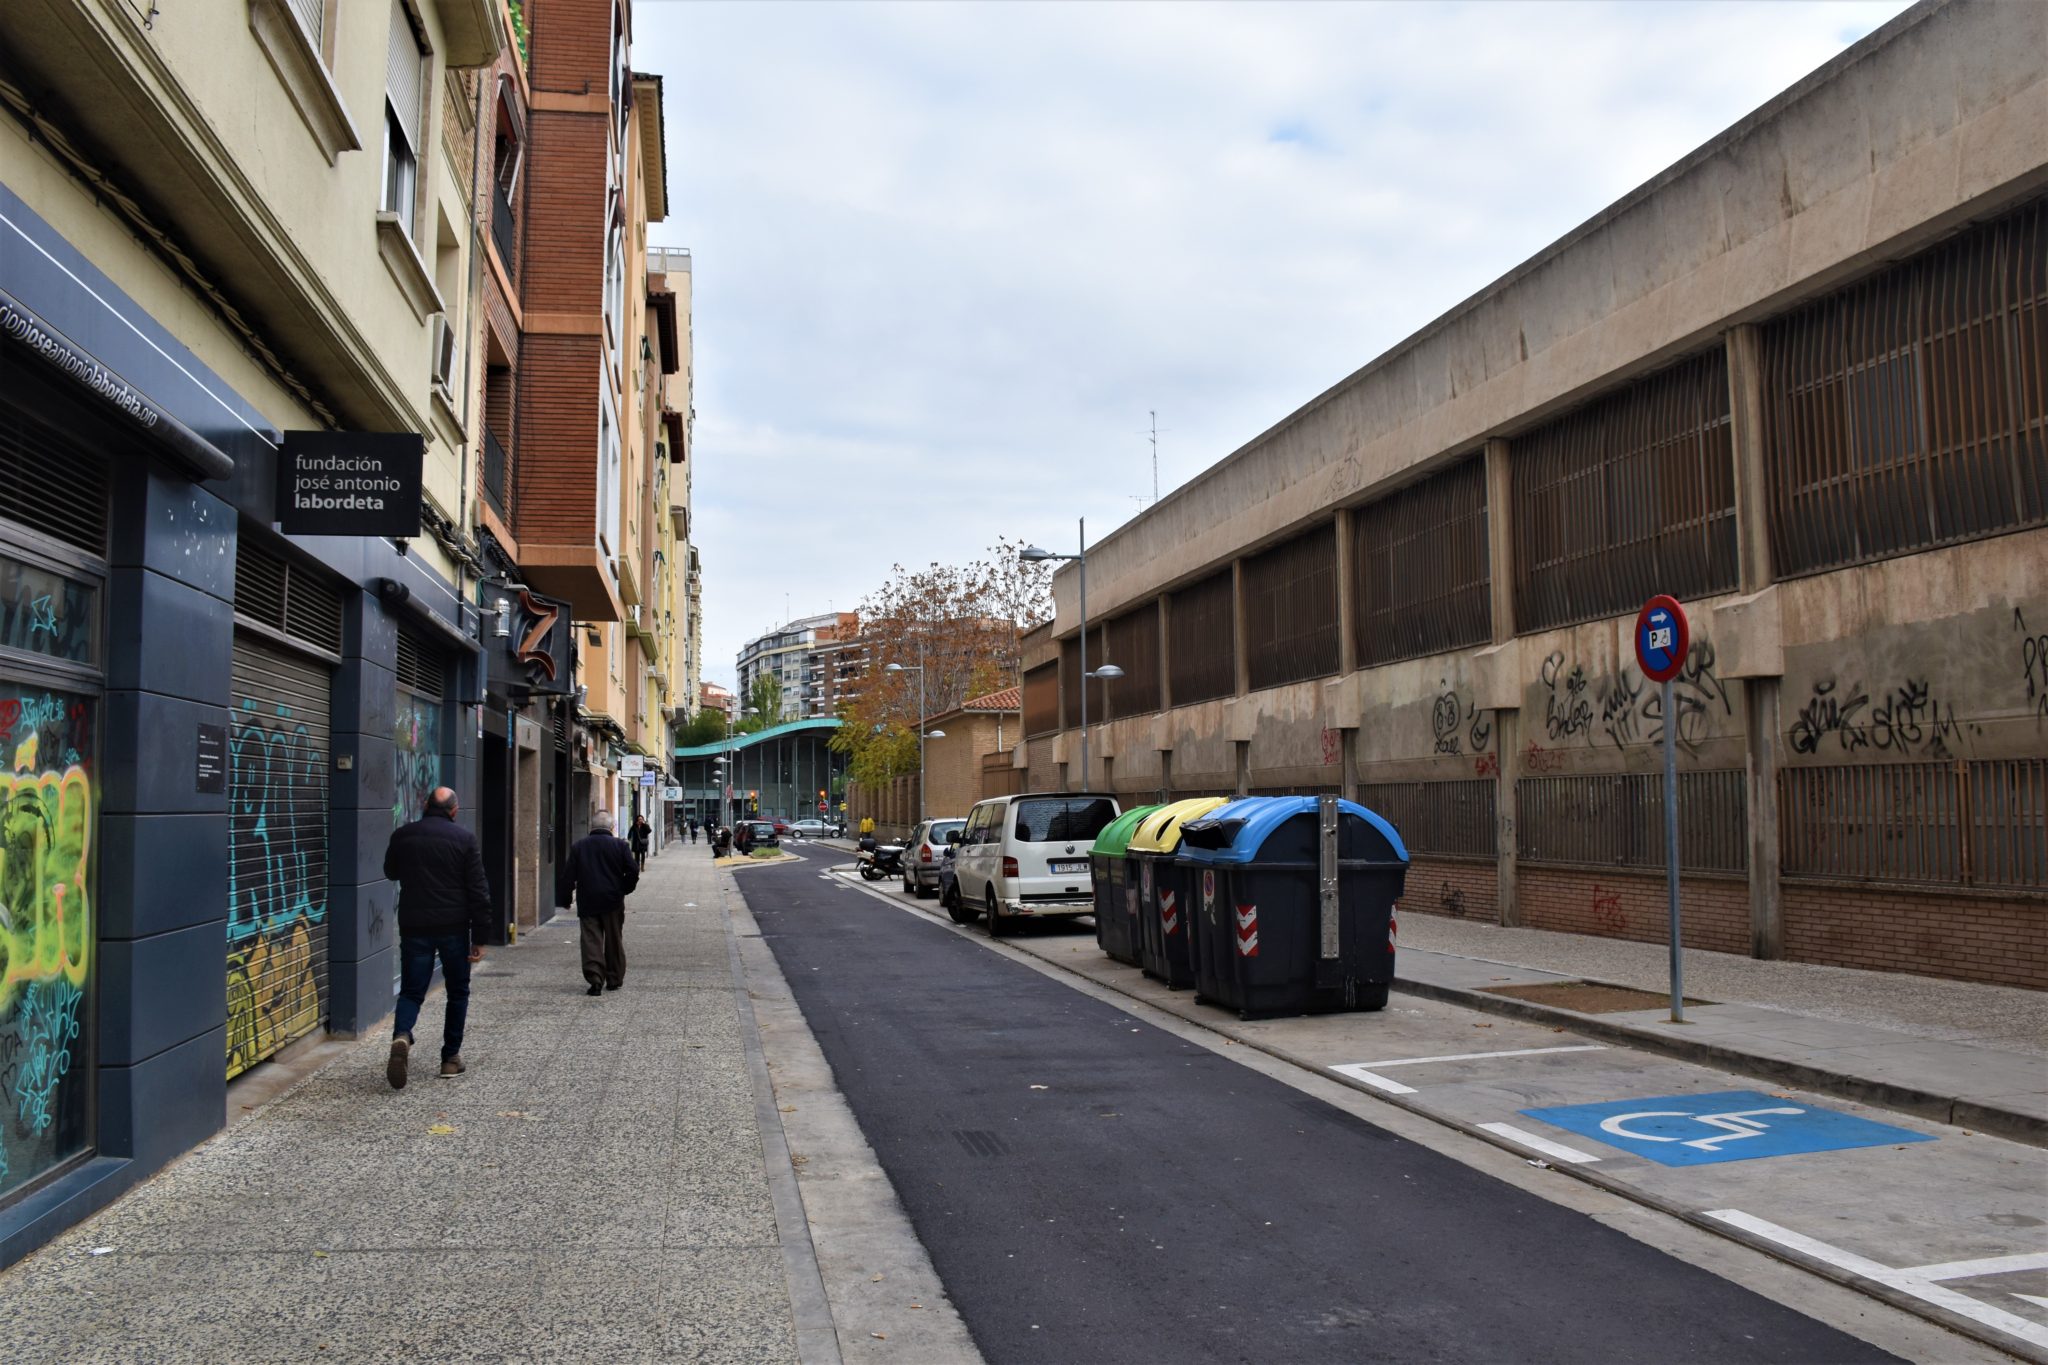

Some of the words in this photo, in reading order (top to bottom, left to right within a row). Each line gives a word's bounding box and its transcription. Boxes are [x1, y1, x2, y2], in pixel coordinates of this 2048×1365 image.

[296, 454, 382, 472] fundación
[294, 475, 330, 493] josé
[334, 476, 401, 492] antonio
[295, 493, 384, 510] labordeta
[1651, 632, 1657, 647] P
